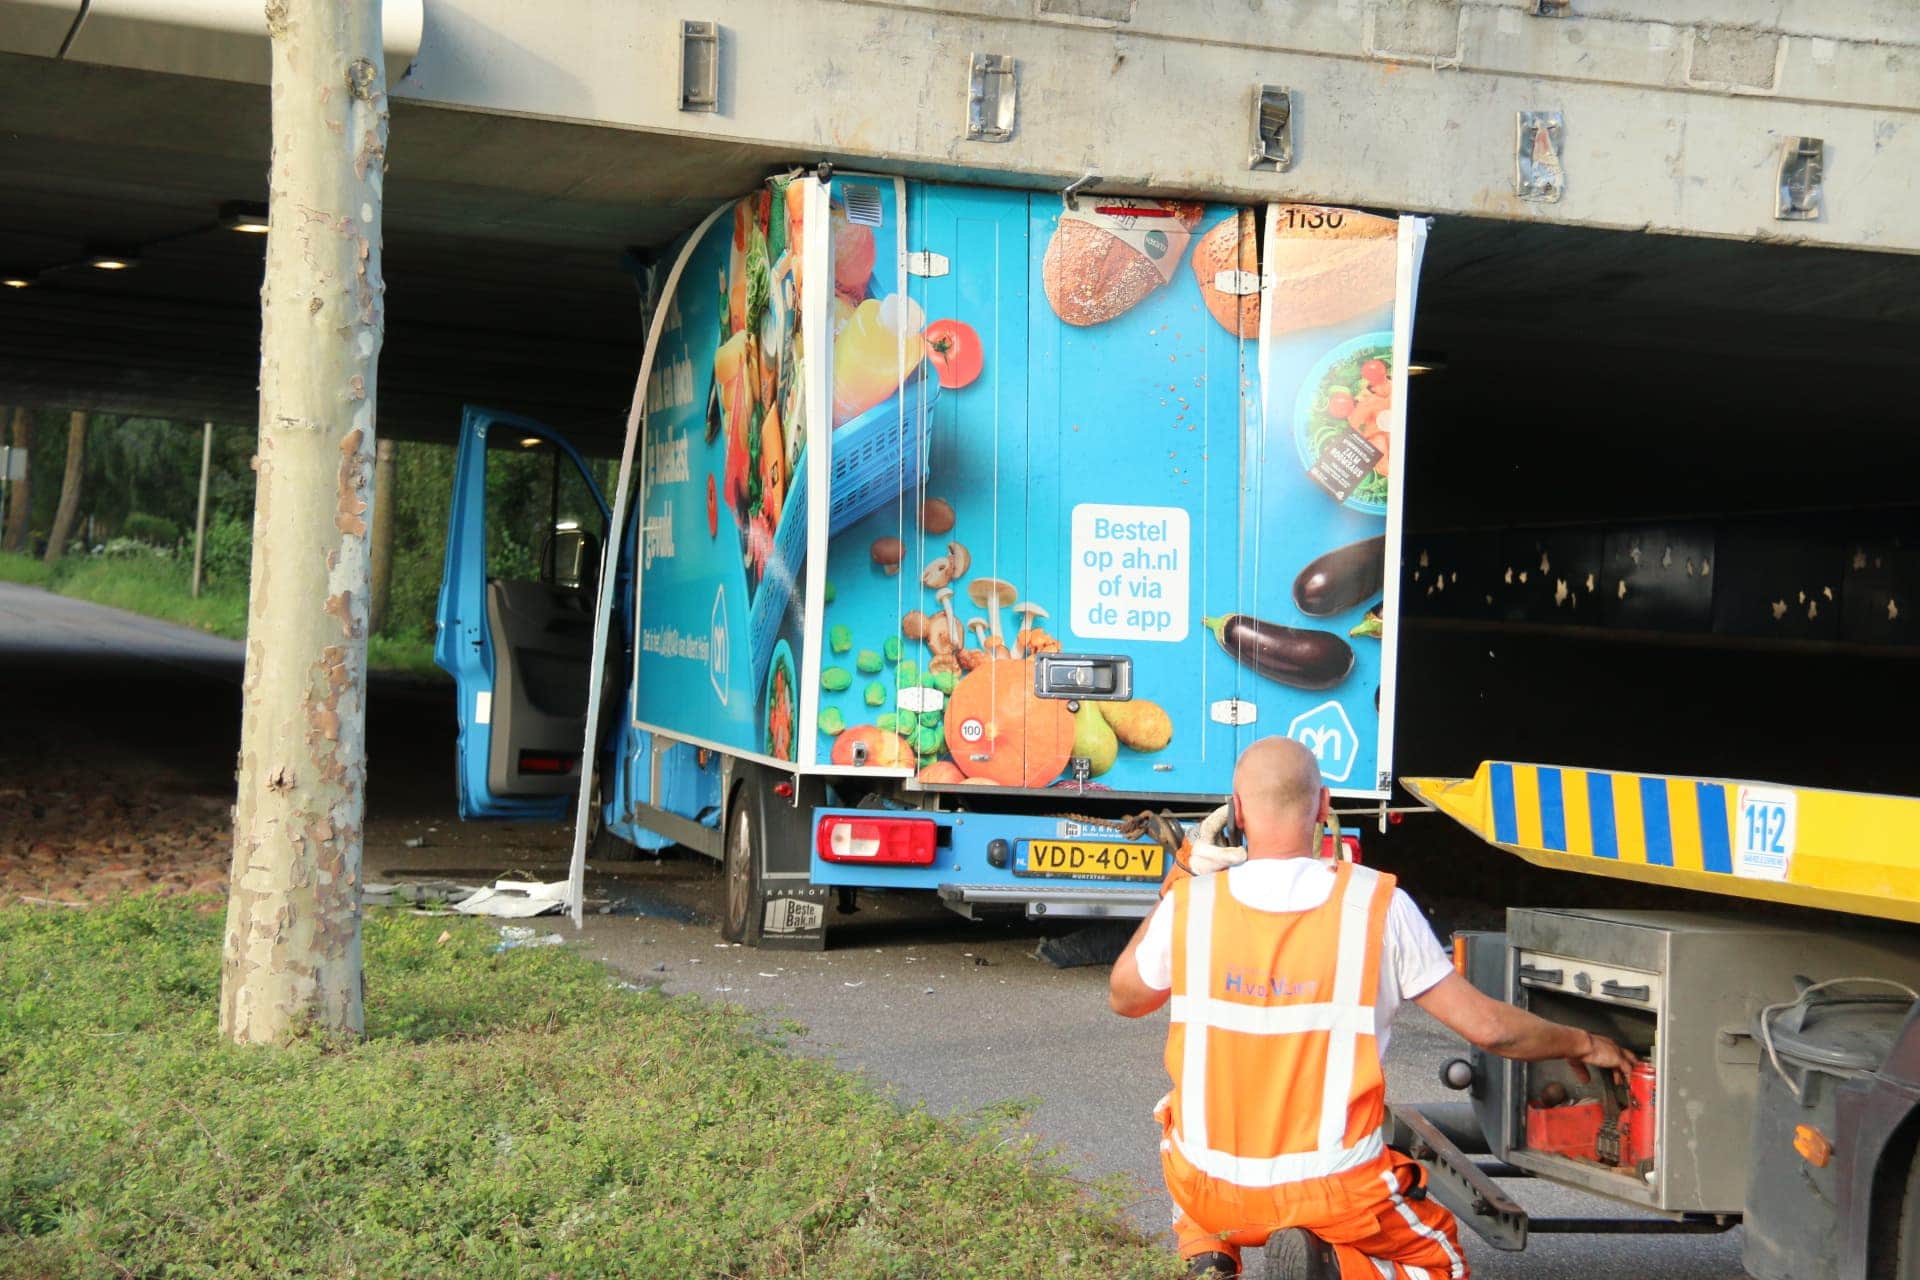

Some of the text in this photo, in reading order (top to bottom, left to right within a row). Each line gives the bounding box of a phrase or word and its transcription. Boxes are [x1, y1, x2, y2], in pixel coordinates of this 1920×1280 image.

[1094, 517, 1167, 542] Bestel
[1083, 547, 1178, 572] op ah.nl
[1098, 574, 1162, 599] of via
[1088, 602, 1171, 632] de app
[964, 726, 981, 736] 100
[1016, 858, 1027, 866] NL
[1034, 845, 1155, 871] VDD-40-V
[788, 901, 815, 916] Beste
